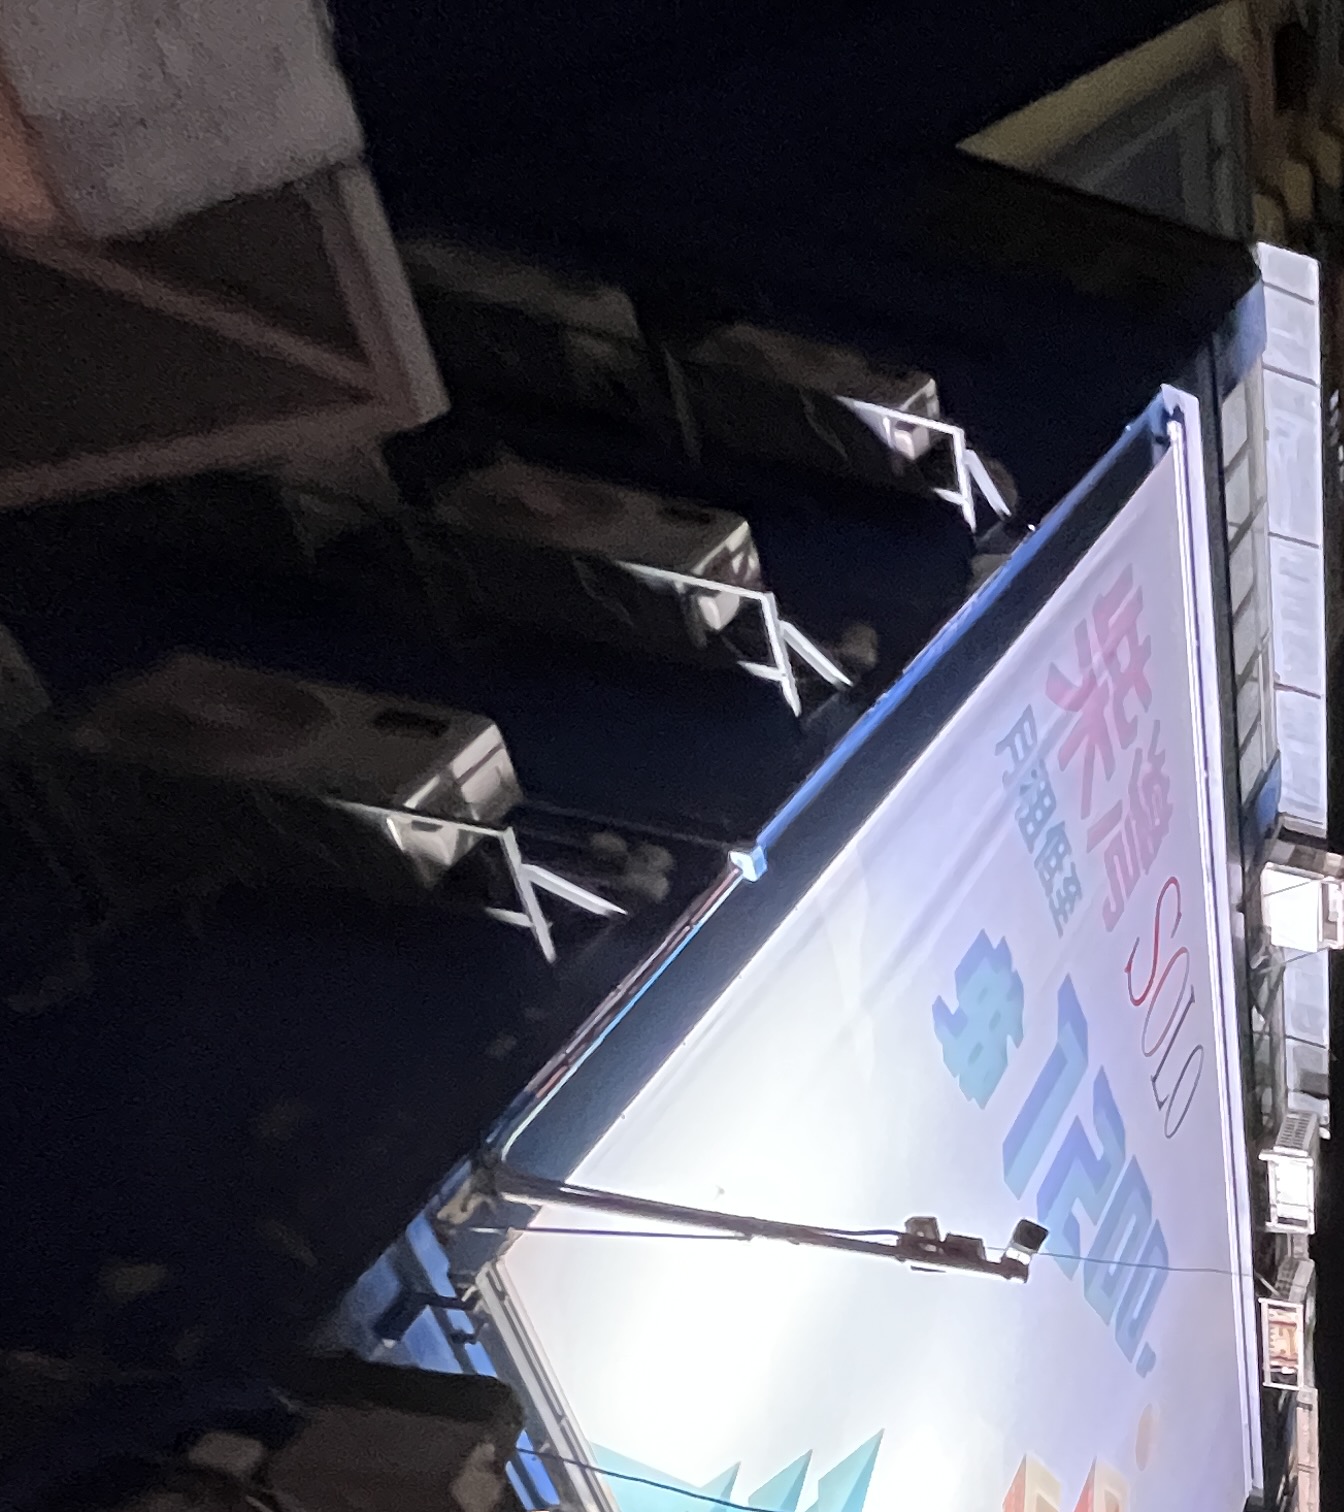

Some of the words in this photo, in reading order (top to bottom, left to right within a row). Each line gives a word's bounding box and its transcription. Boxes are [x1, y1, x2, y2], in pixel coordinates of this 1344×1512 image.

[994, 705, 1083, 938] 月租低至
[1045, 563, 1173, 932] 柴灣
[1124, 874, 1204, 1139] SOLO
